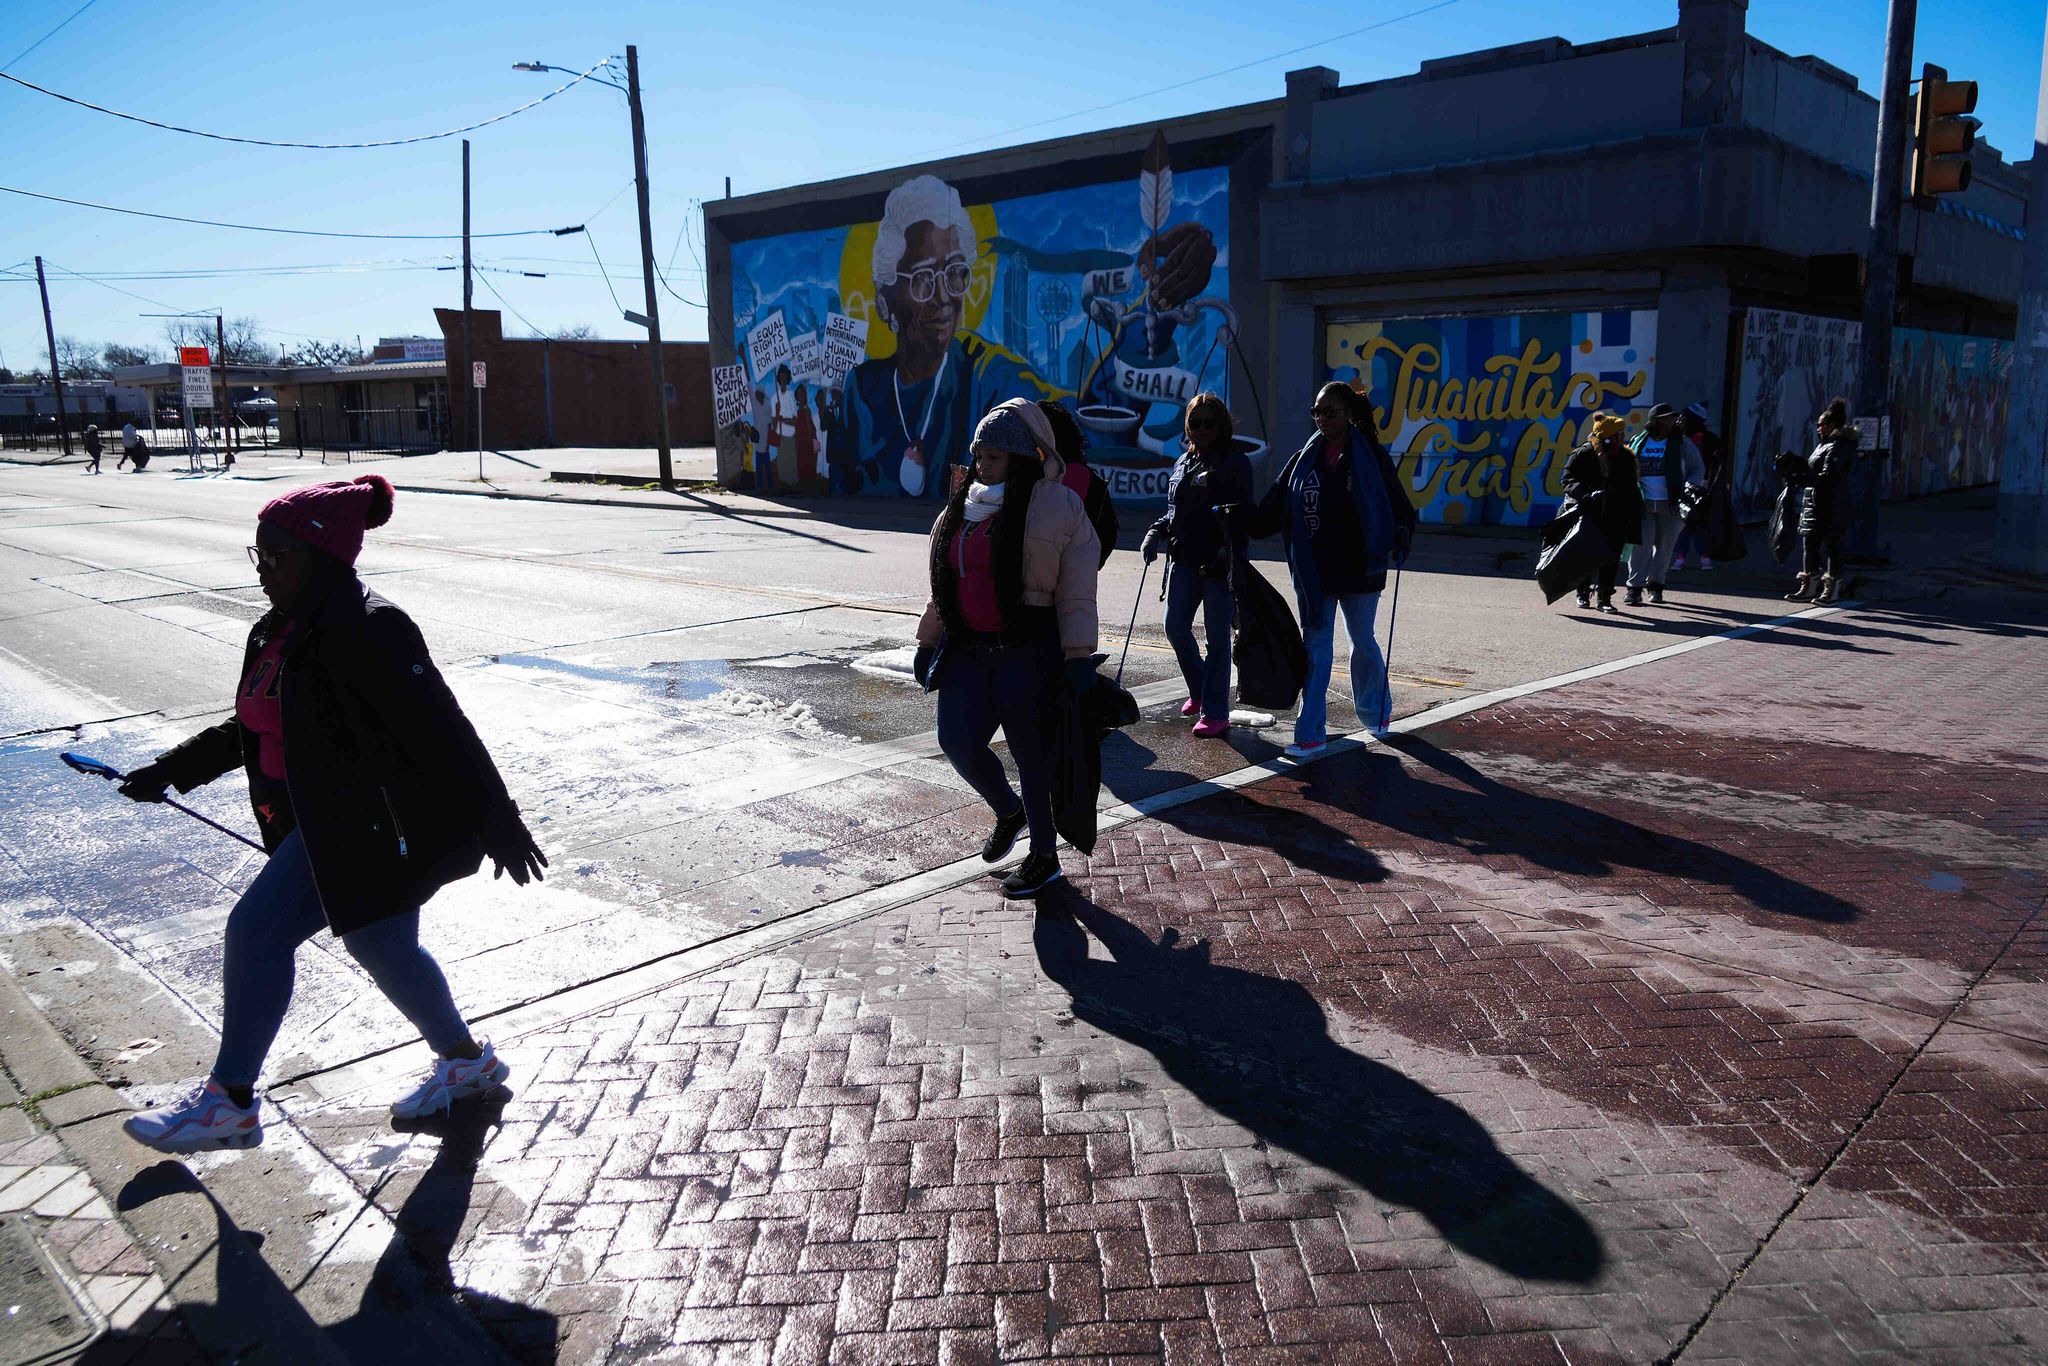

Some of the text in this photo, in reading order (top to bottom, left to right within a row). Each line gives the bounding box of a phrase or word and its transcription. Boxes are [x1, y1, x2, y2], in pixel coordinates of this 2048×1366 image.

[1092, 270, 1127, 296] WE
[757, 317, 784, 343] EQUAL
[826, 326, 866, 349] DETERMINATION
[833, 317, 855, 332] SELF
[753, 330, 784, 357] RIGHTS
[827, 340, 857, 361] HUMAN
[756, 343, 789, 373] FOR ALL
[797, 353, 804, 361] IS
[184, 367, 209, 375] TRAFFIC
[714, 365, 743, 385] KEEP
[186, 384, 211, 392] DOUBLE
[717, 379, 744, 396] SOUTH
[717, 385, 749, 411] DALLAS
[1123, 369, 1188, 401] SHALL
[1361, 337, 1647, 445] Juanita
[718, 400, 748, 426] SUNNY
[1397, 419, 1577, 514] Craft
[1094, 467, 1170, 495] VERCO
